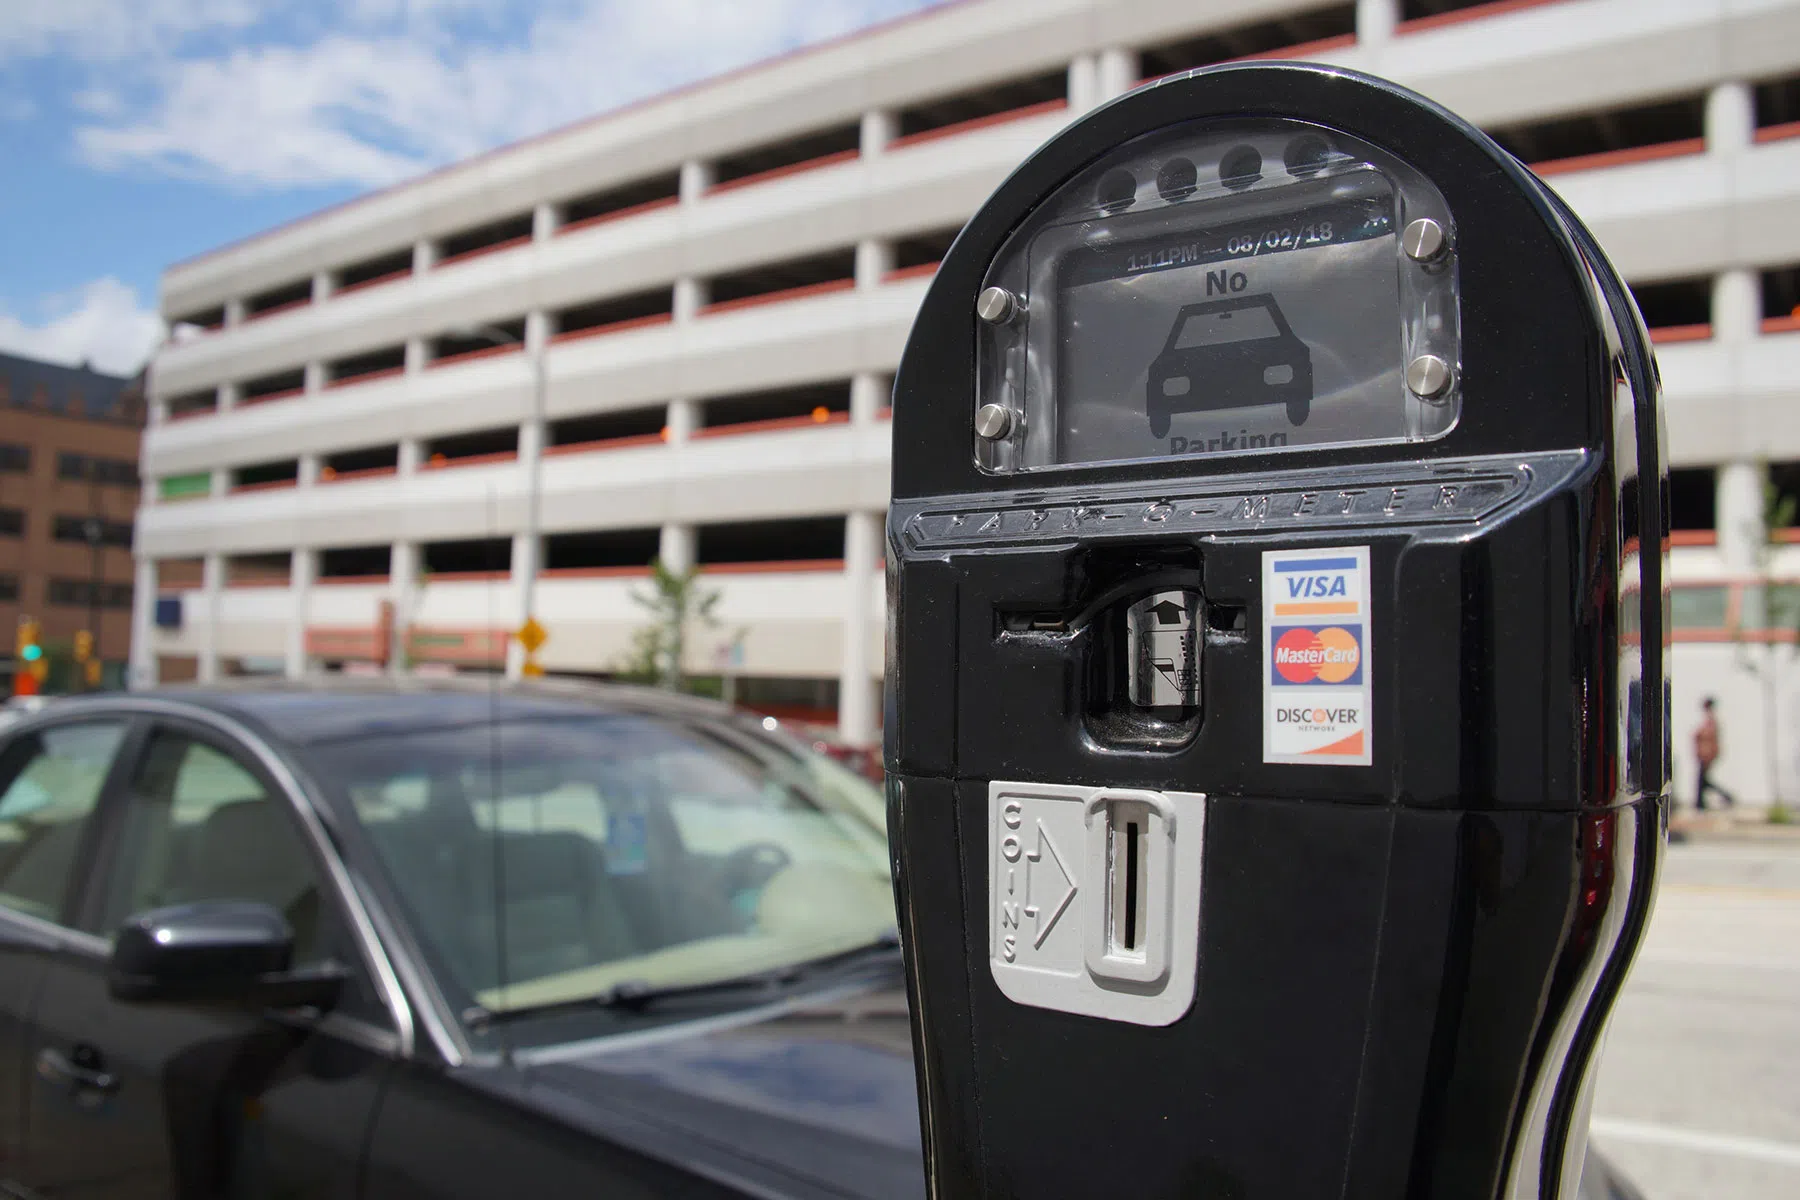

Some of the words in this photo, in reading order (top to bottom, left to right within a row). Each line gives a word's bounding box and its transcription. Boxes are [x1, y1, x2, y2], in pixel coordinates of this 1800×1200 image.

[1227, 221, 1333, 255] 08/02/18
[1206, 269, 1249, 296] No
[1170, 429, 1287, 455] Parking
[1287, 575, 1347, 598] VISA
[1276, 646, 1358, 664] MasterCard
[1276, 708, 1358, 724] DISCOVER
[1298, 725, 1336, 733] NETWORK
[1002, 802, 1022, 964] COINS
